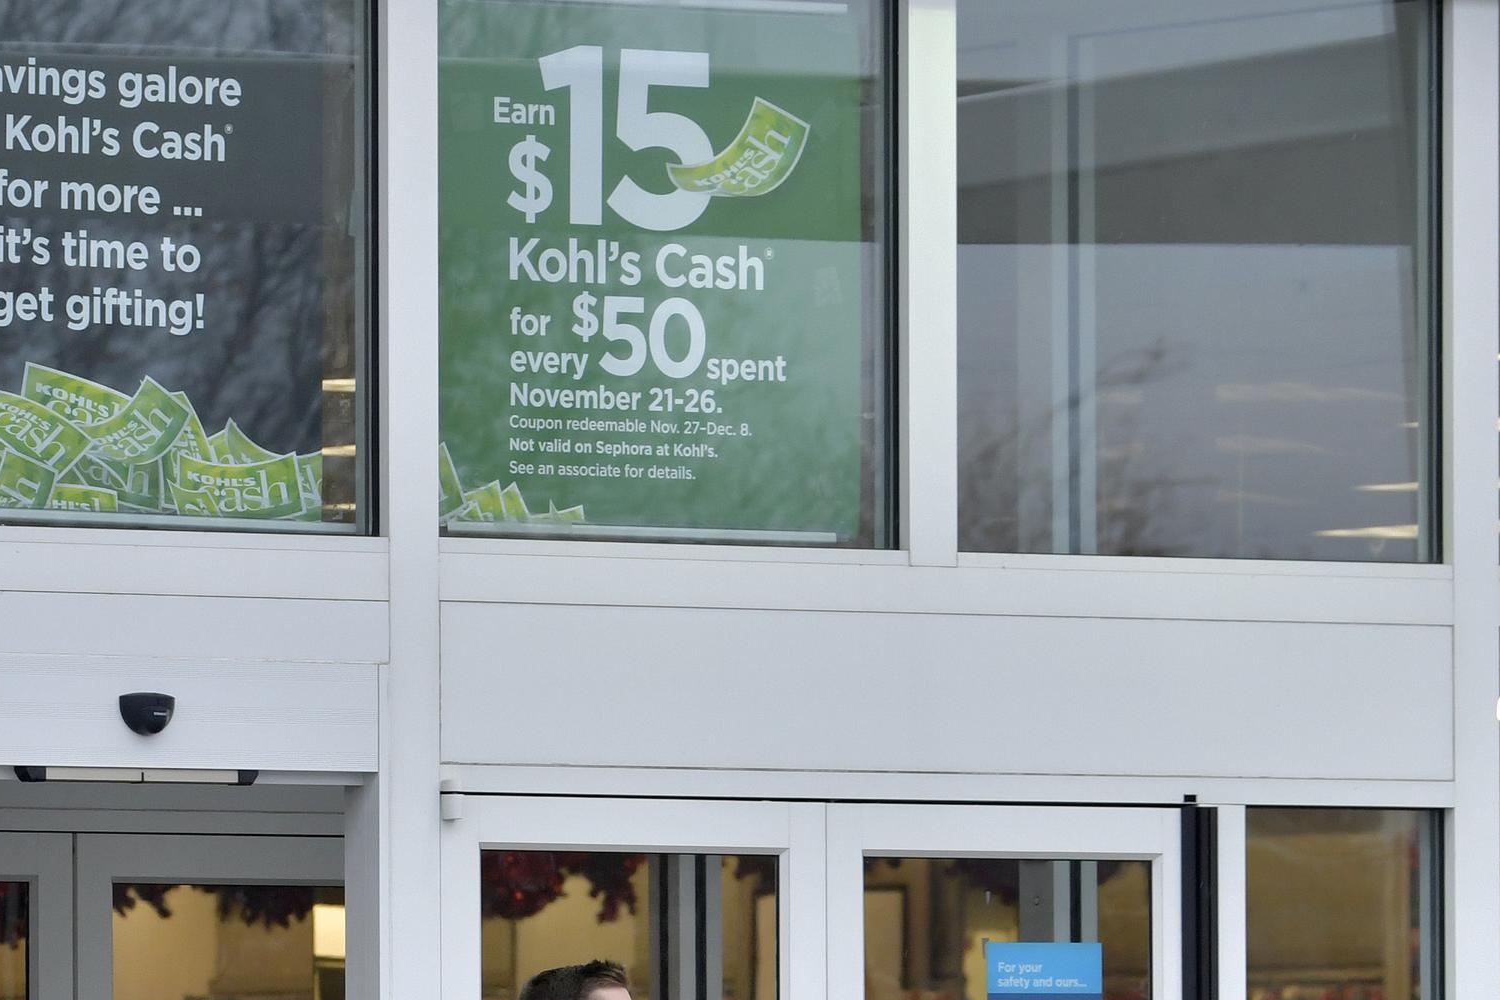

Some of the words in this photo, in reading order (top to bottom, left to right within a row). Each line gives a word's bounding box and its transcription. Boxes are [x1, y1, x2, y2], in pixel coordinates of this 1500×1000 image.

[119, 66, 242, 107] galore
[493, 97, 555, 126] Earn
[5, 114, 120, 156] Kohl's
[60, 181, 160, 214] more
[62, 230, 149, 271] time
[161, 235, 201, 273] to
[509, 238, 640, 286] Kohl's
[66, 289, 205, 335] gifting!
[510, 307, 551, 336] for
[510, 350, 588, 380] every
[707, 356, 787, 384] spent
[35, 382, 109, 417] KOHL'S
[510, 382, 641, 411] November
[649, 388, 723, 414] 21-26.
[509, 415, 563, 431] Coupon
[566, 416, 647, 433] redeemable
[650, 420, 680, 434] Nov.
[740, 423, 753, 436] 8.
[509, 438, 534, 452] Not
[538, 439, 571, 453] valid
[574, 442, 592, 454] on
[596, 441, 652, 457] Sephora
[656, 443, 670, 456] at
[673, 443, 718, 458] Kohl's.
[188, 471, 256, 487] KOHL'S
[509, 460, 534, 474] See
[538, 464, 554, 475] an
[558, 463, 621, 477] associate
[624, 464, 644, 478] for
[647, 465, 697, 480] details.
[998, 962, 1016, 973] For
[1018, 963, 1043, 975] your
[998, 976, 1030, 990] safety
[1033, 976, 1053, 988] and
[1055, 978, 1087, 988] ours...
